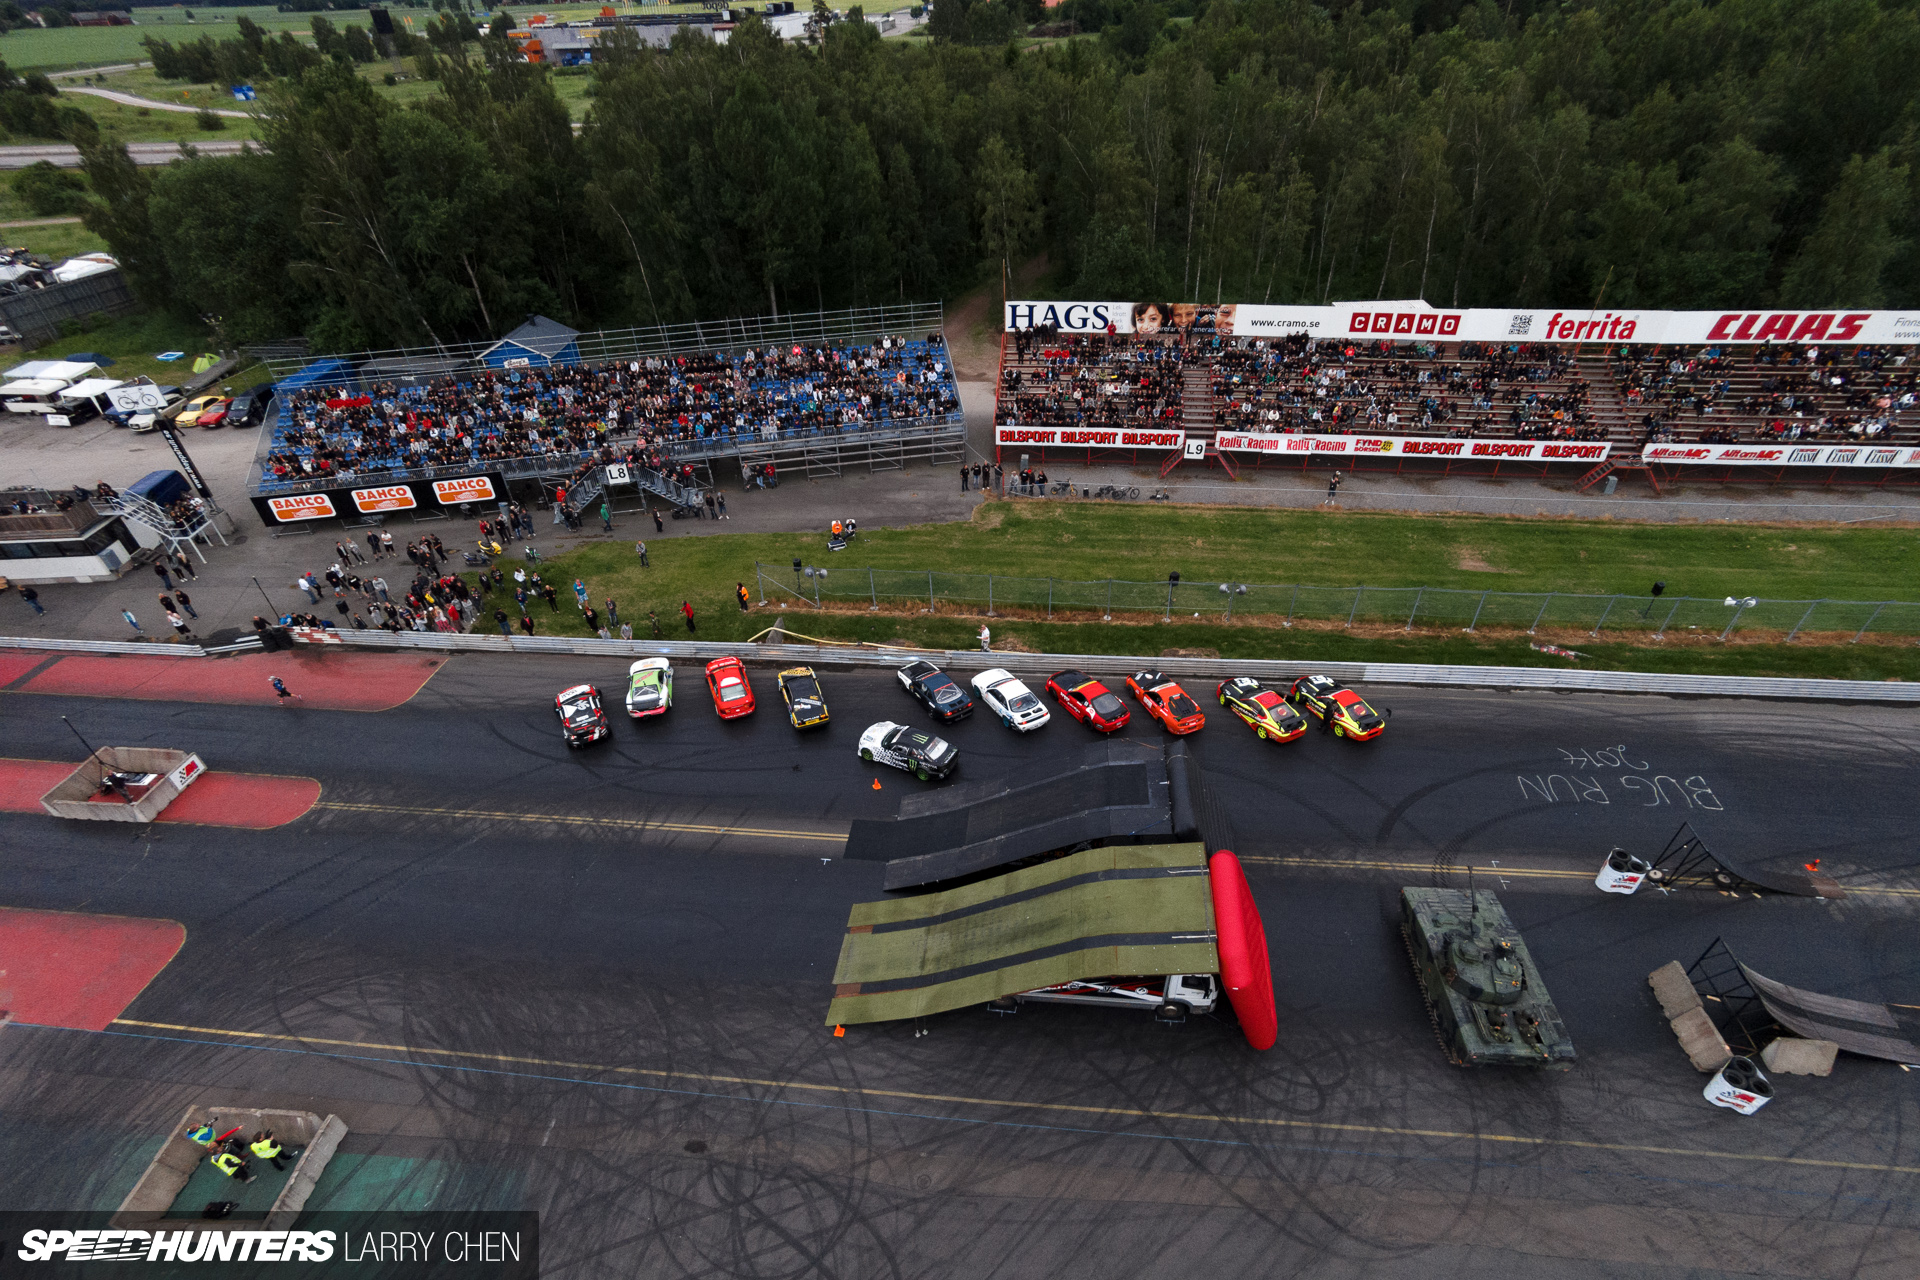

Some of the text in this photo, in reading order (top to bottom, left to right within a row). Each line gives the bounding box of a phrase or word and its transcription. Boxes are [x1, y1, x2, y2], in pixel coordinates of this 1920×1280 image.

[1008, 304, 1109, 330] HAGS
[1251, 319, 1320, 328] www.cramo.se
[1353, 316, 1456, 332] CRAMO
[1545, 312, 1637, 340] ferrita
[1705, 313, 1873, 341] CLAAS
[999, 430, 1057, 443] BILSPORT
[1060, 431, 1118, 444] BILSPORT
[1121, 432, 1180, 446] BILSPORT
[1355, 438, 1383, 447] FYND
[1186, 443, 1204, 455] L9
[1402, 441, 1464, 455] BILSPORT
[1471, 443, 1535, 457] BILSPORT
[1541, 445, 1606, 458] BILSPORT
[608, 467, 627, 480] L8
[436, 478, 487, 493] BAHCO
[355, 487, 407, 501] BAHCO
[272, 495, 326, 510] BAHCO
[1557, 744, 1649, 771] 2014
[1517, 775, 1724, 811] BUG RUN
